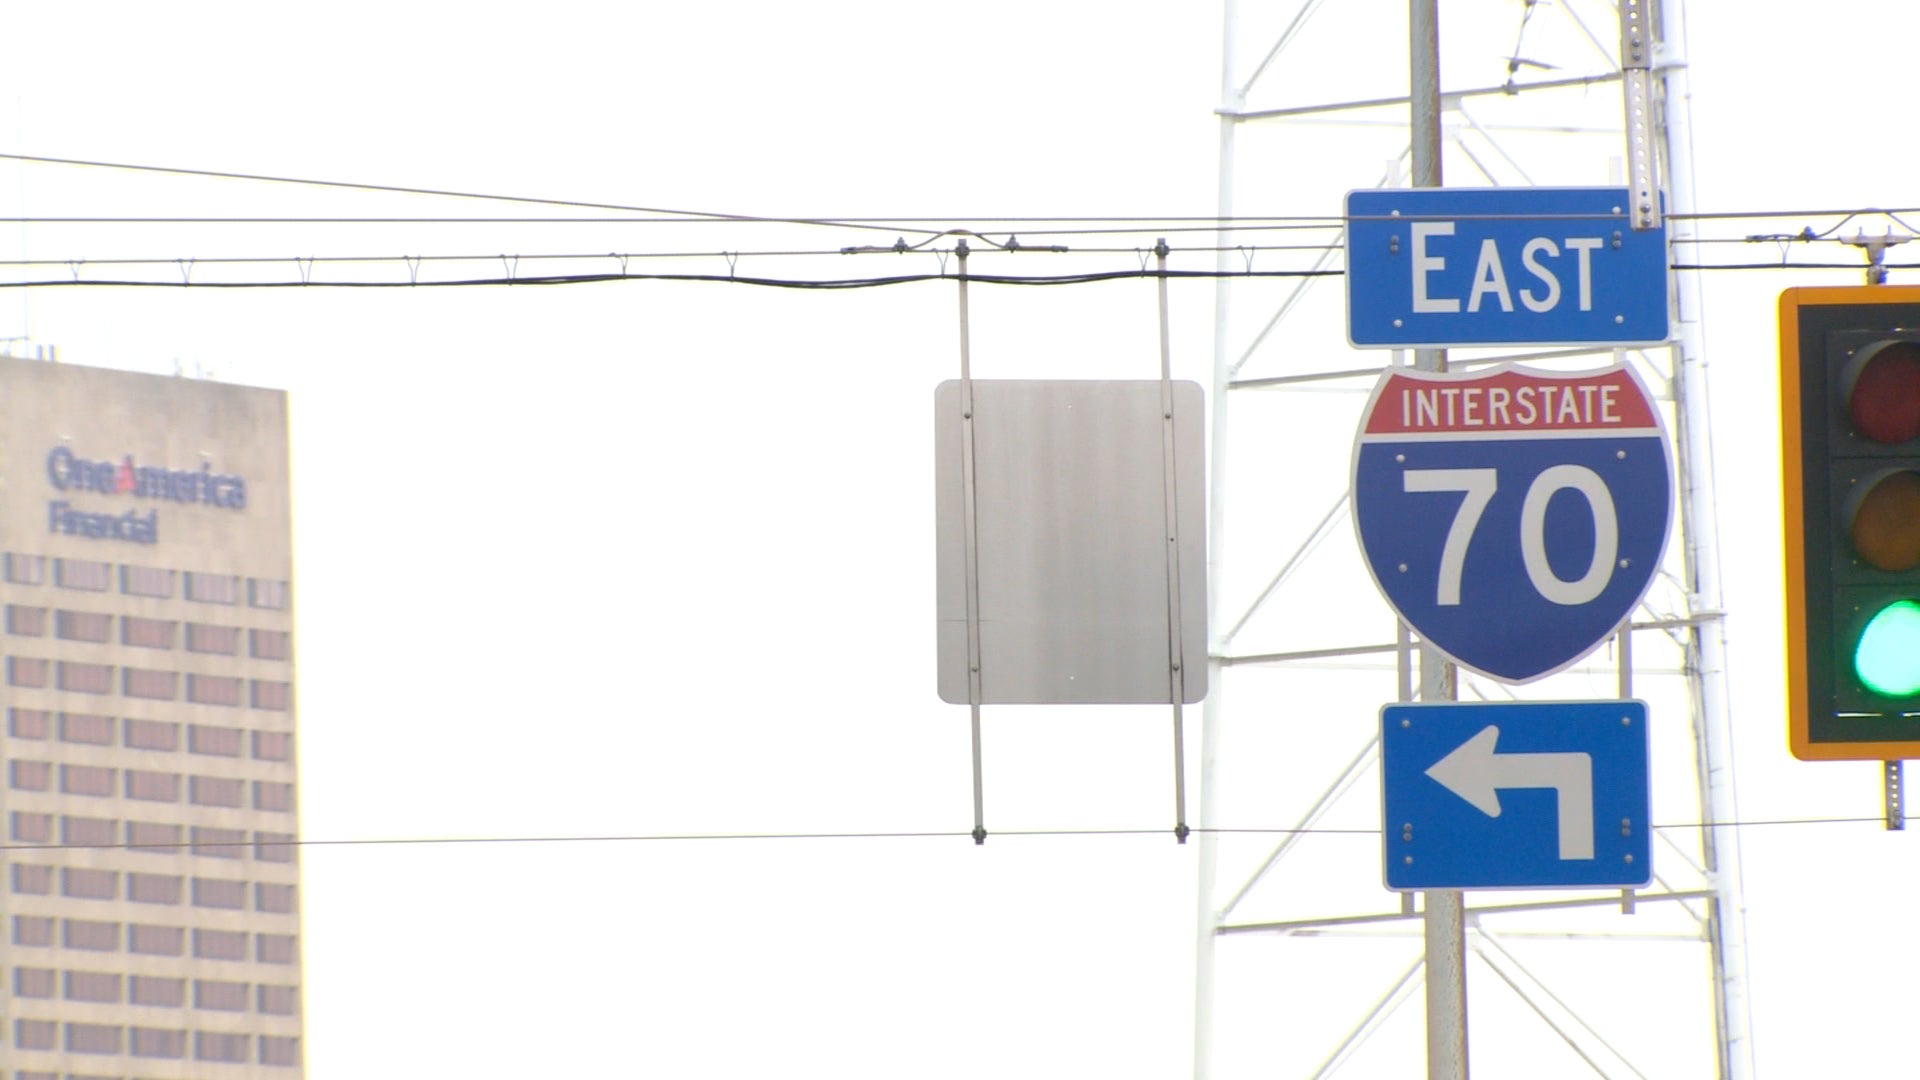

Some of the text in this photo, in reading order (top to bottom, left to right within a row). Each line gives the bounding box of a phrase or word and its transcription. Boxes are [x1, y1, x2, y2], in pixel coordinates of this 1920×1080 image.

[1411, 222, 1603, 313] EAST
[1402, 385, 1621, 426] INTERSTATE
[47, 446, 246, 509] OneAmerica
[48, 500, 158, 544] Financial
[1403, 464, 1618, 605] 70
